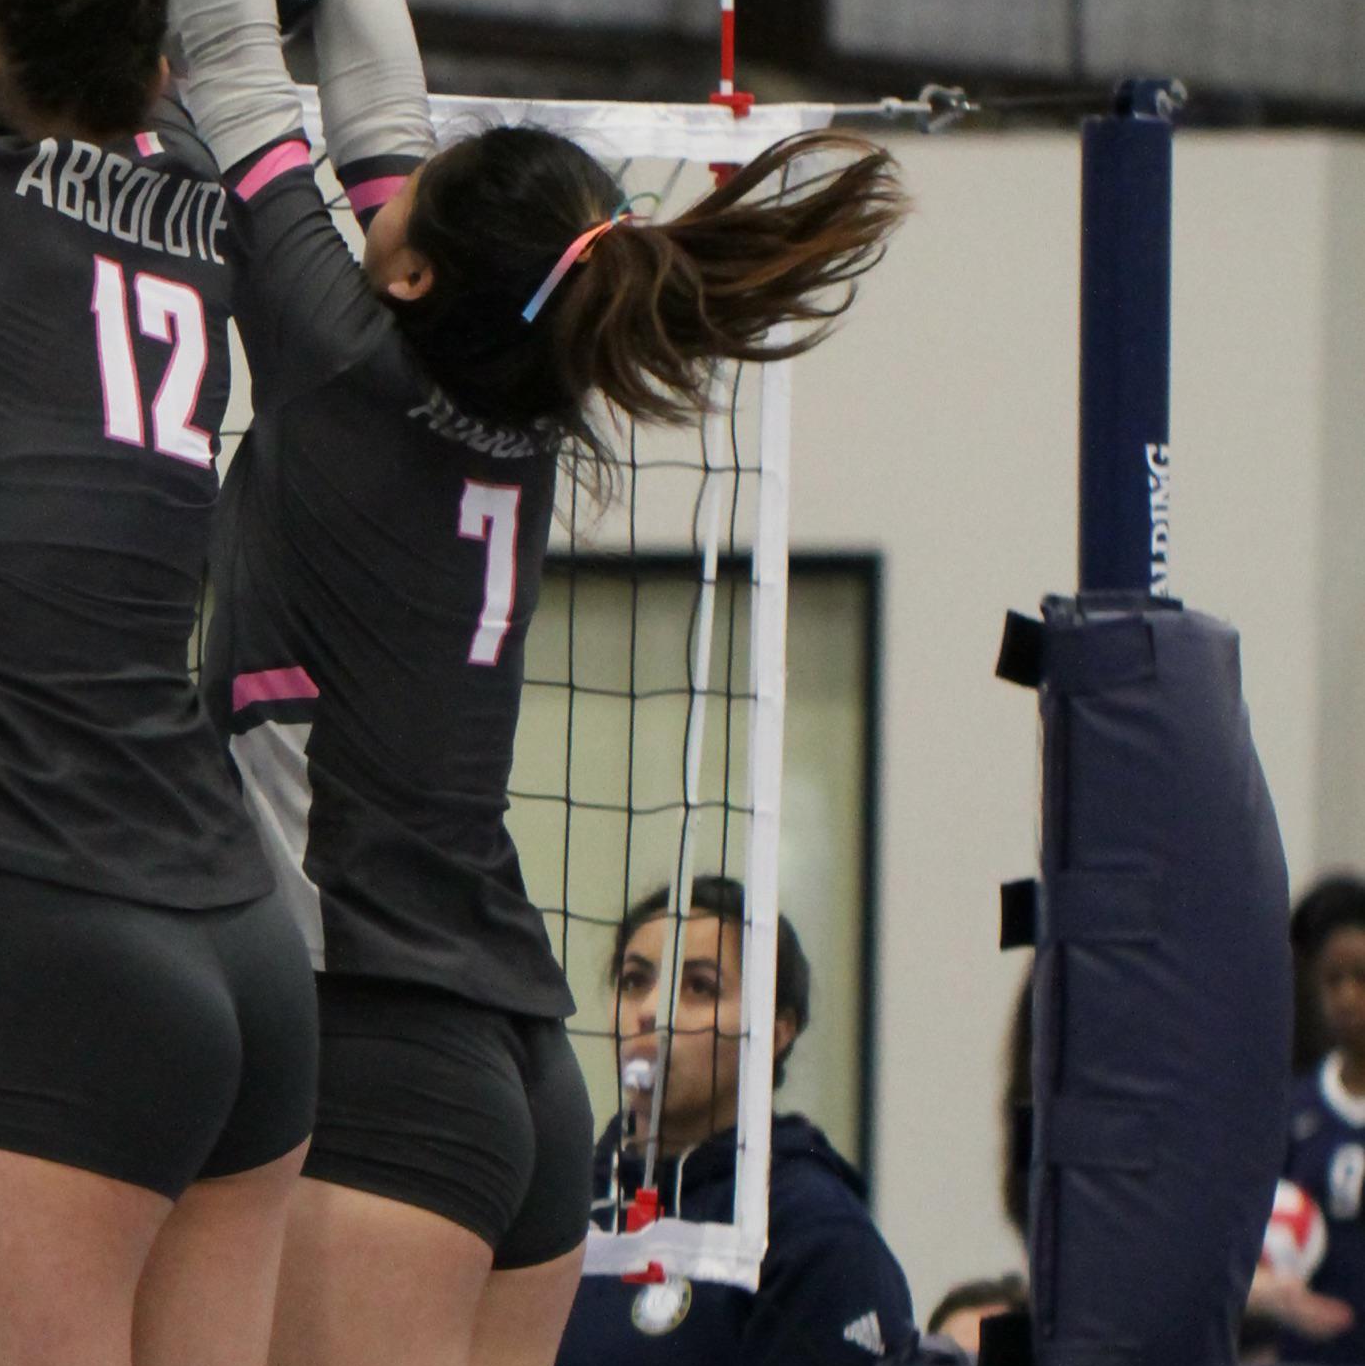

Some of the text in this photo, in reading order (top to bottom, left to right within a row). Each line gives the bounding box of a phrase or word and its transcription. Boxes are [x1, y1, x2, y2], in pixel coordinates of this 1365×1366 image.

[15, 136, 228, 265] ABSOLUTE
[90, 252, 213, 469] 12
[458, 478, 522, 667] 7
